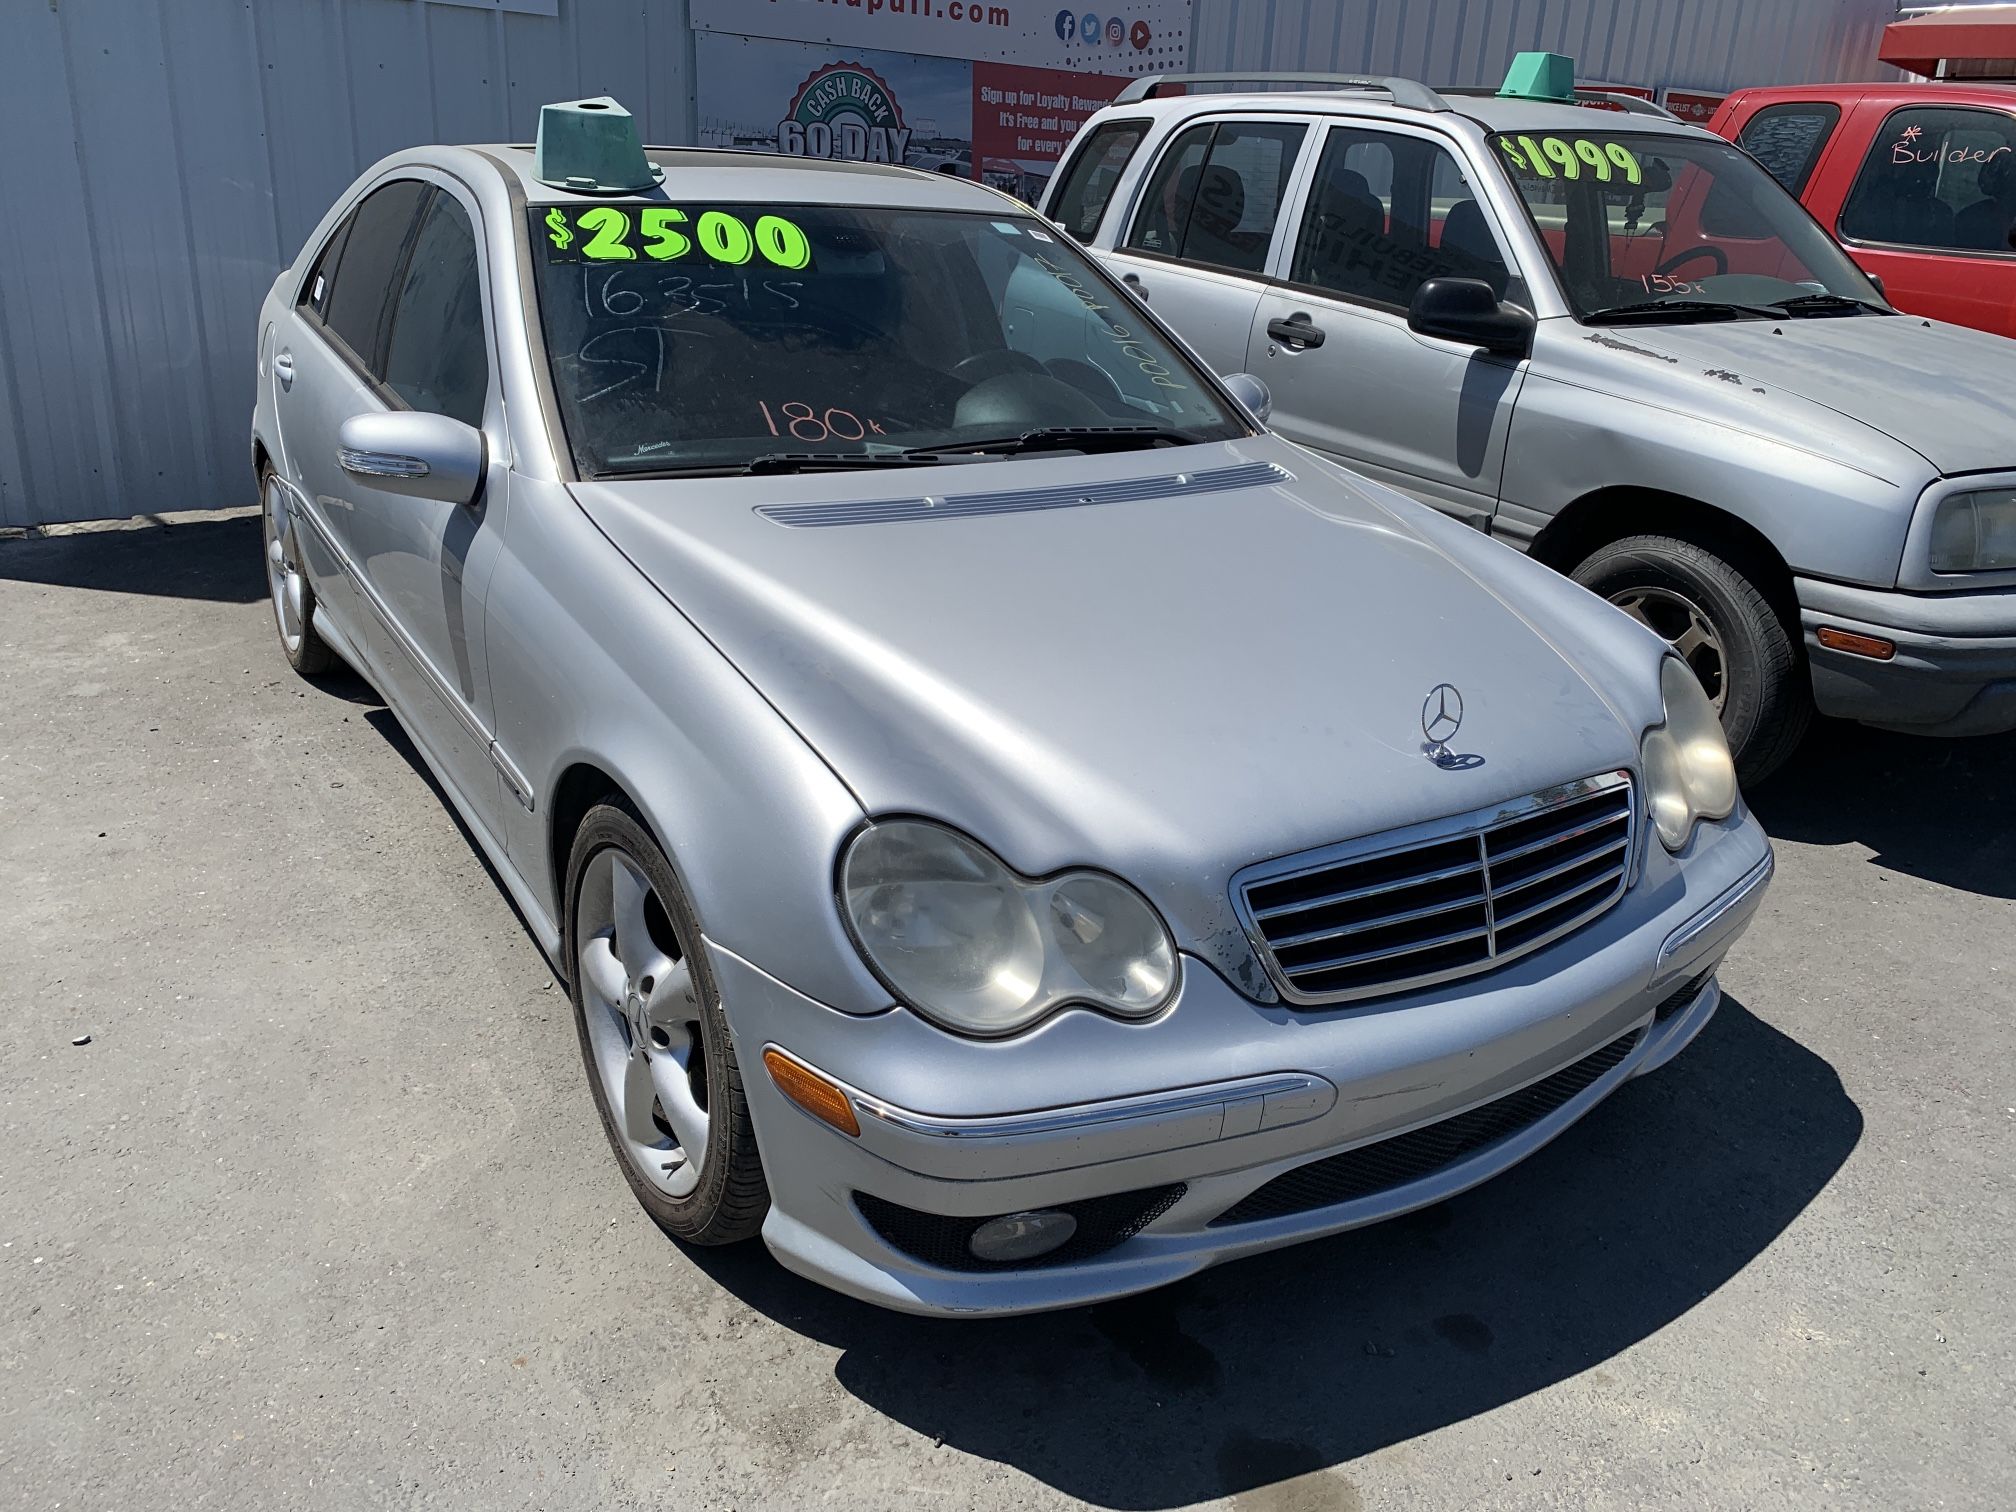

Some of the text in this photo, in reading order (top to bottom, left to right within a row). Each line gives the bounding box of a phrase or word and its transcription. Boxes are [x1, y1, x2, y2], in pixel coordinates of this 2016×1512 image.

[806, 76, 889, 123] CASH BACK
[981, 87, 1003, 104] Sign
[1005, 92, 1017, 106] up
[1020, 90, 1034, 105] for
[1037, 92, 1070, 111] Loyalty
[1000, 112, 1015, 127] It's
[1017, 113, 1039, 129] Free
[1041, 116, 1058, 131] and
[1060, 121, 1077, 133] you
[778, 119, 912, 164] 60 DAY
[1018, 136, 1032, 151] for
[1035, 140, 1062, 155] every
[1891, 141, 2012, 164] Builder
[1499, 135, 1642, 185] $1999
[545, 207, 811, 270] $2500
